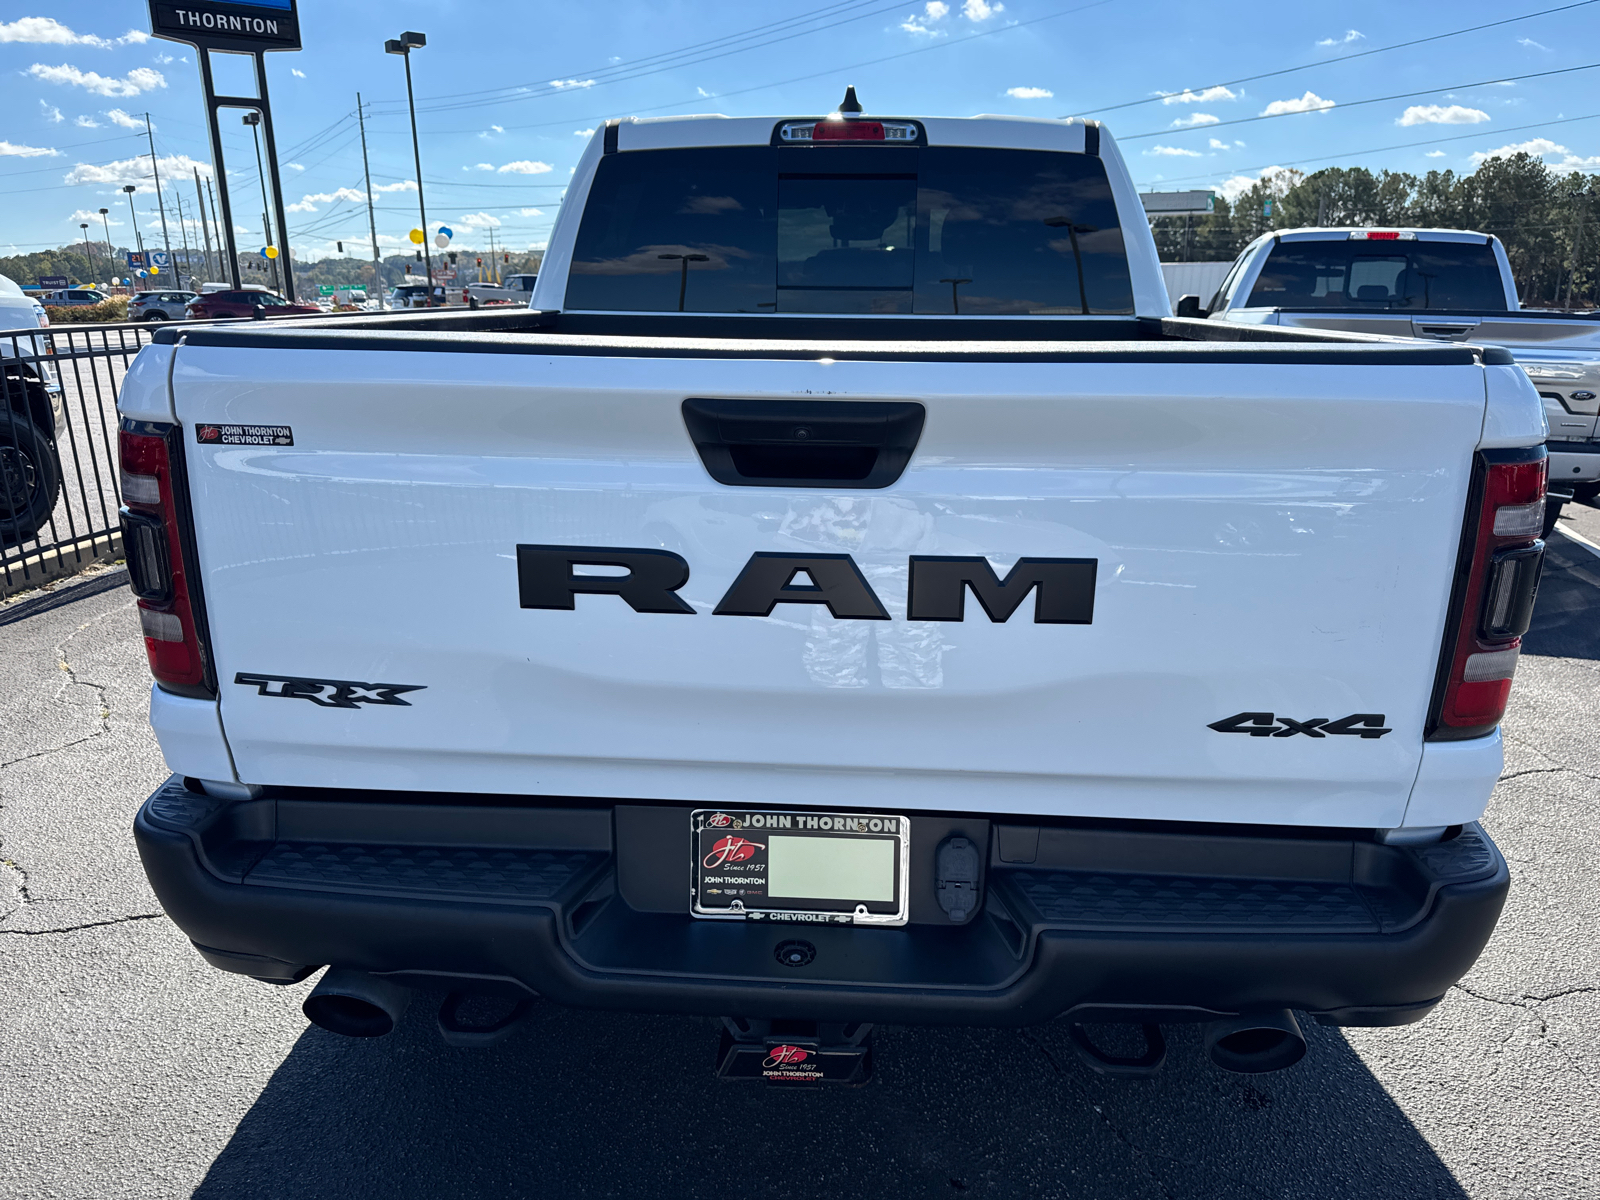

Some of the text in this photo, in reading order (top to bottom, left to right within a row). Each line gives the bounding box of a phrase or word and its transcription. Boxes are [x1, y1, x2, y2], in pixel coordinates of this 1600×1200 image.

[175, 10, 278, 35] THORNTON
[221, 426, 290, 437] JOHN THORNTON
[221, 435, 274, 444] CHEVROLET
[516, 543, 1098, 625] RAM
[234, 672, 428, 709] TRX
[1206, 712, 1393, 739] 4x4
[742, 814, 897, 833] JOHN THORNTON
[723, 863, 766, 872] Since 1957
[704, 876, 766, 885] JOHN THORNTON
[769, 912, 831, 923] CHEVROLET
